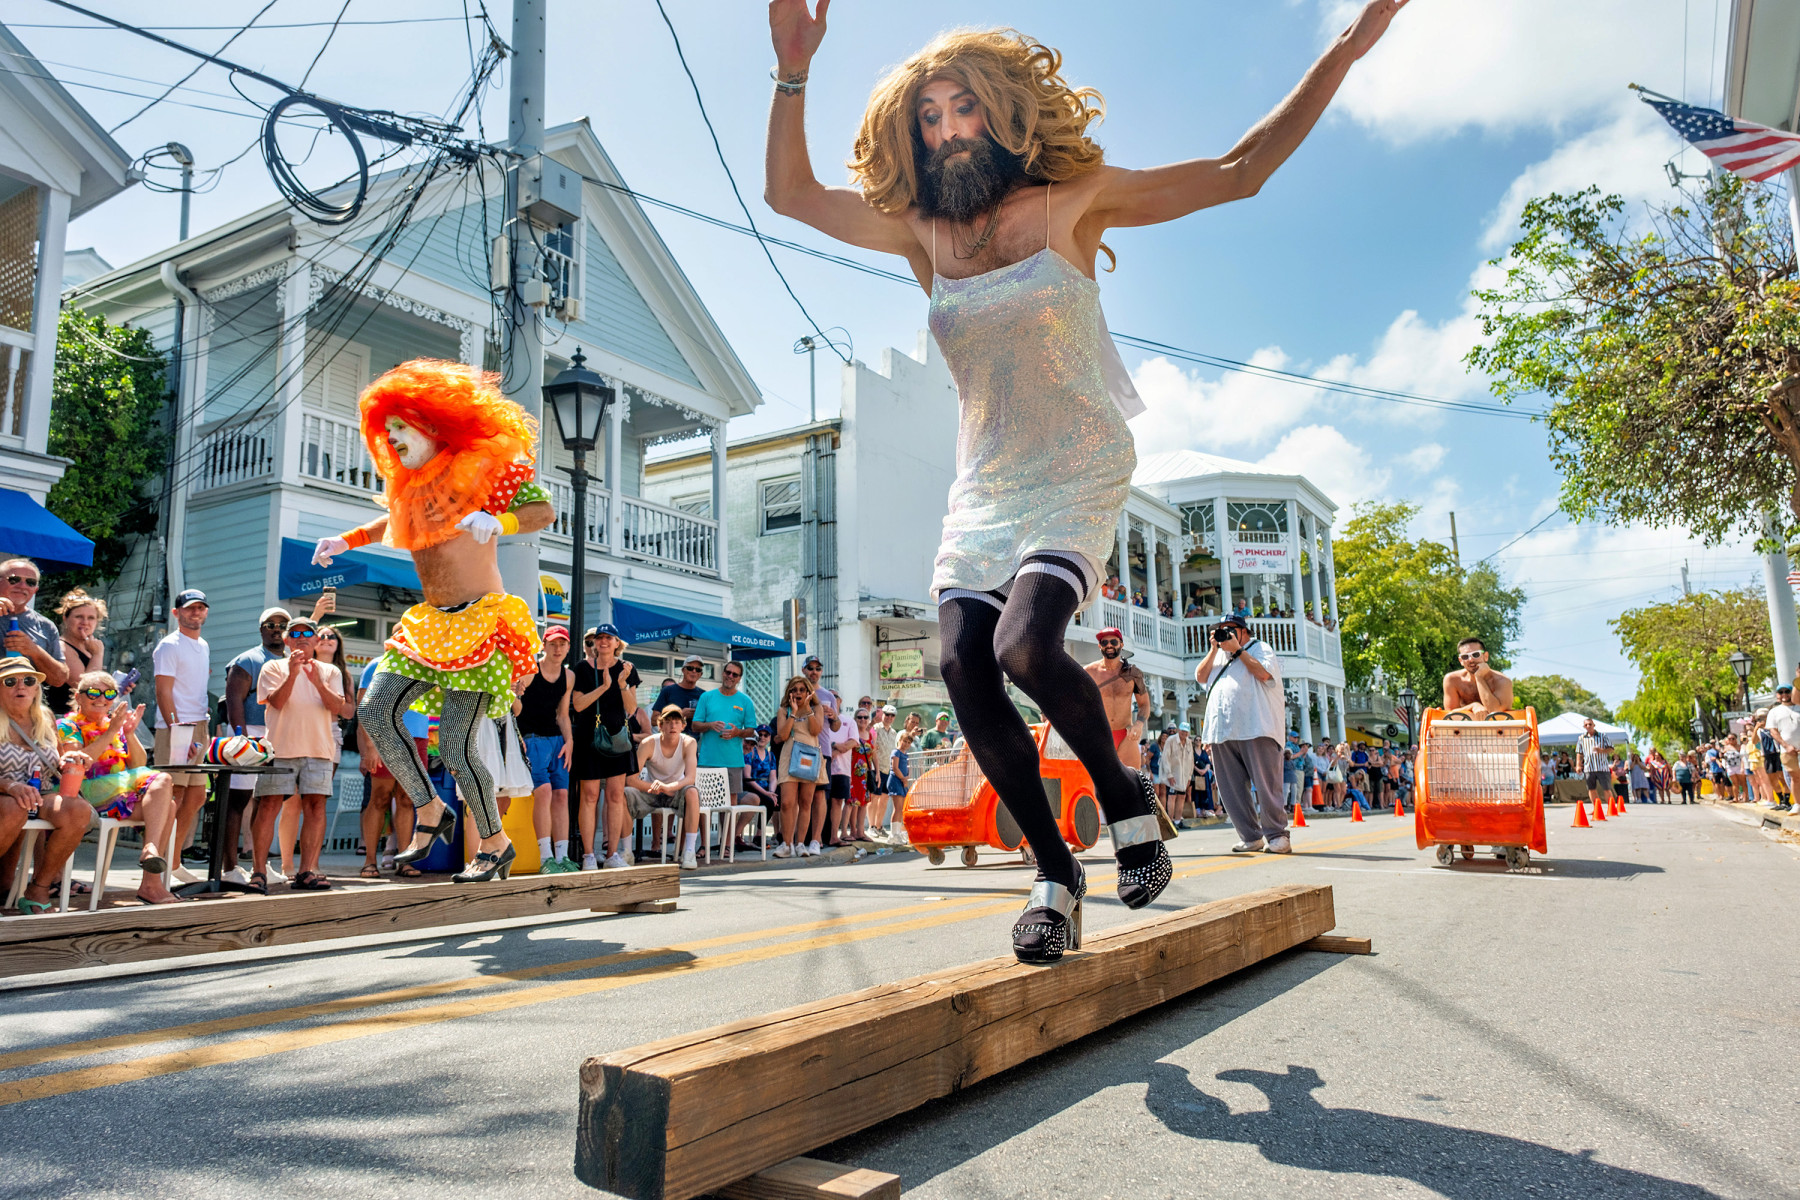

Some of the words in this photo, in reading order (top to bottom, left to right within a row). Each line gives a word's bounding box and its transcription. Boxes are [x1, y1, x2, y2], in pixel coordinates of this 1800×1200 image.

[301, 580, 322, 591] COLD
[322, 575, 345, 587] BEER
[545, 586, 569, 600] West
[635, 631, 659, 640] SHAVE
[660, 629, 673, 637] ICE
[731, 635, 742, 643] ICE
[742, 636, 759, 645] COLD
[758, 638, 776, 647] BEER
[891, 653, 921, 661] Flamingo
[896, 661, 919, 669] Boutique
[881, 683, 922, 691] SUNGLASSES
